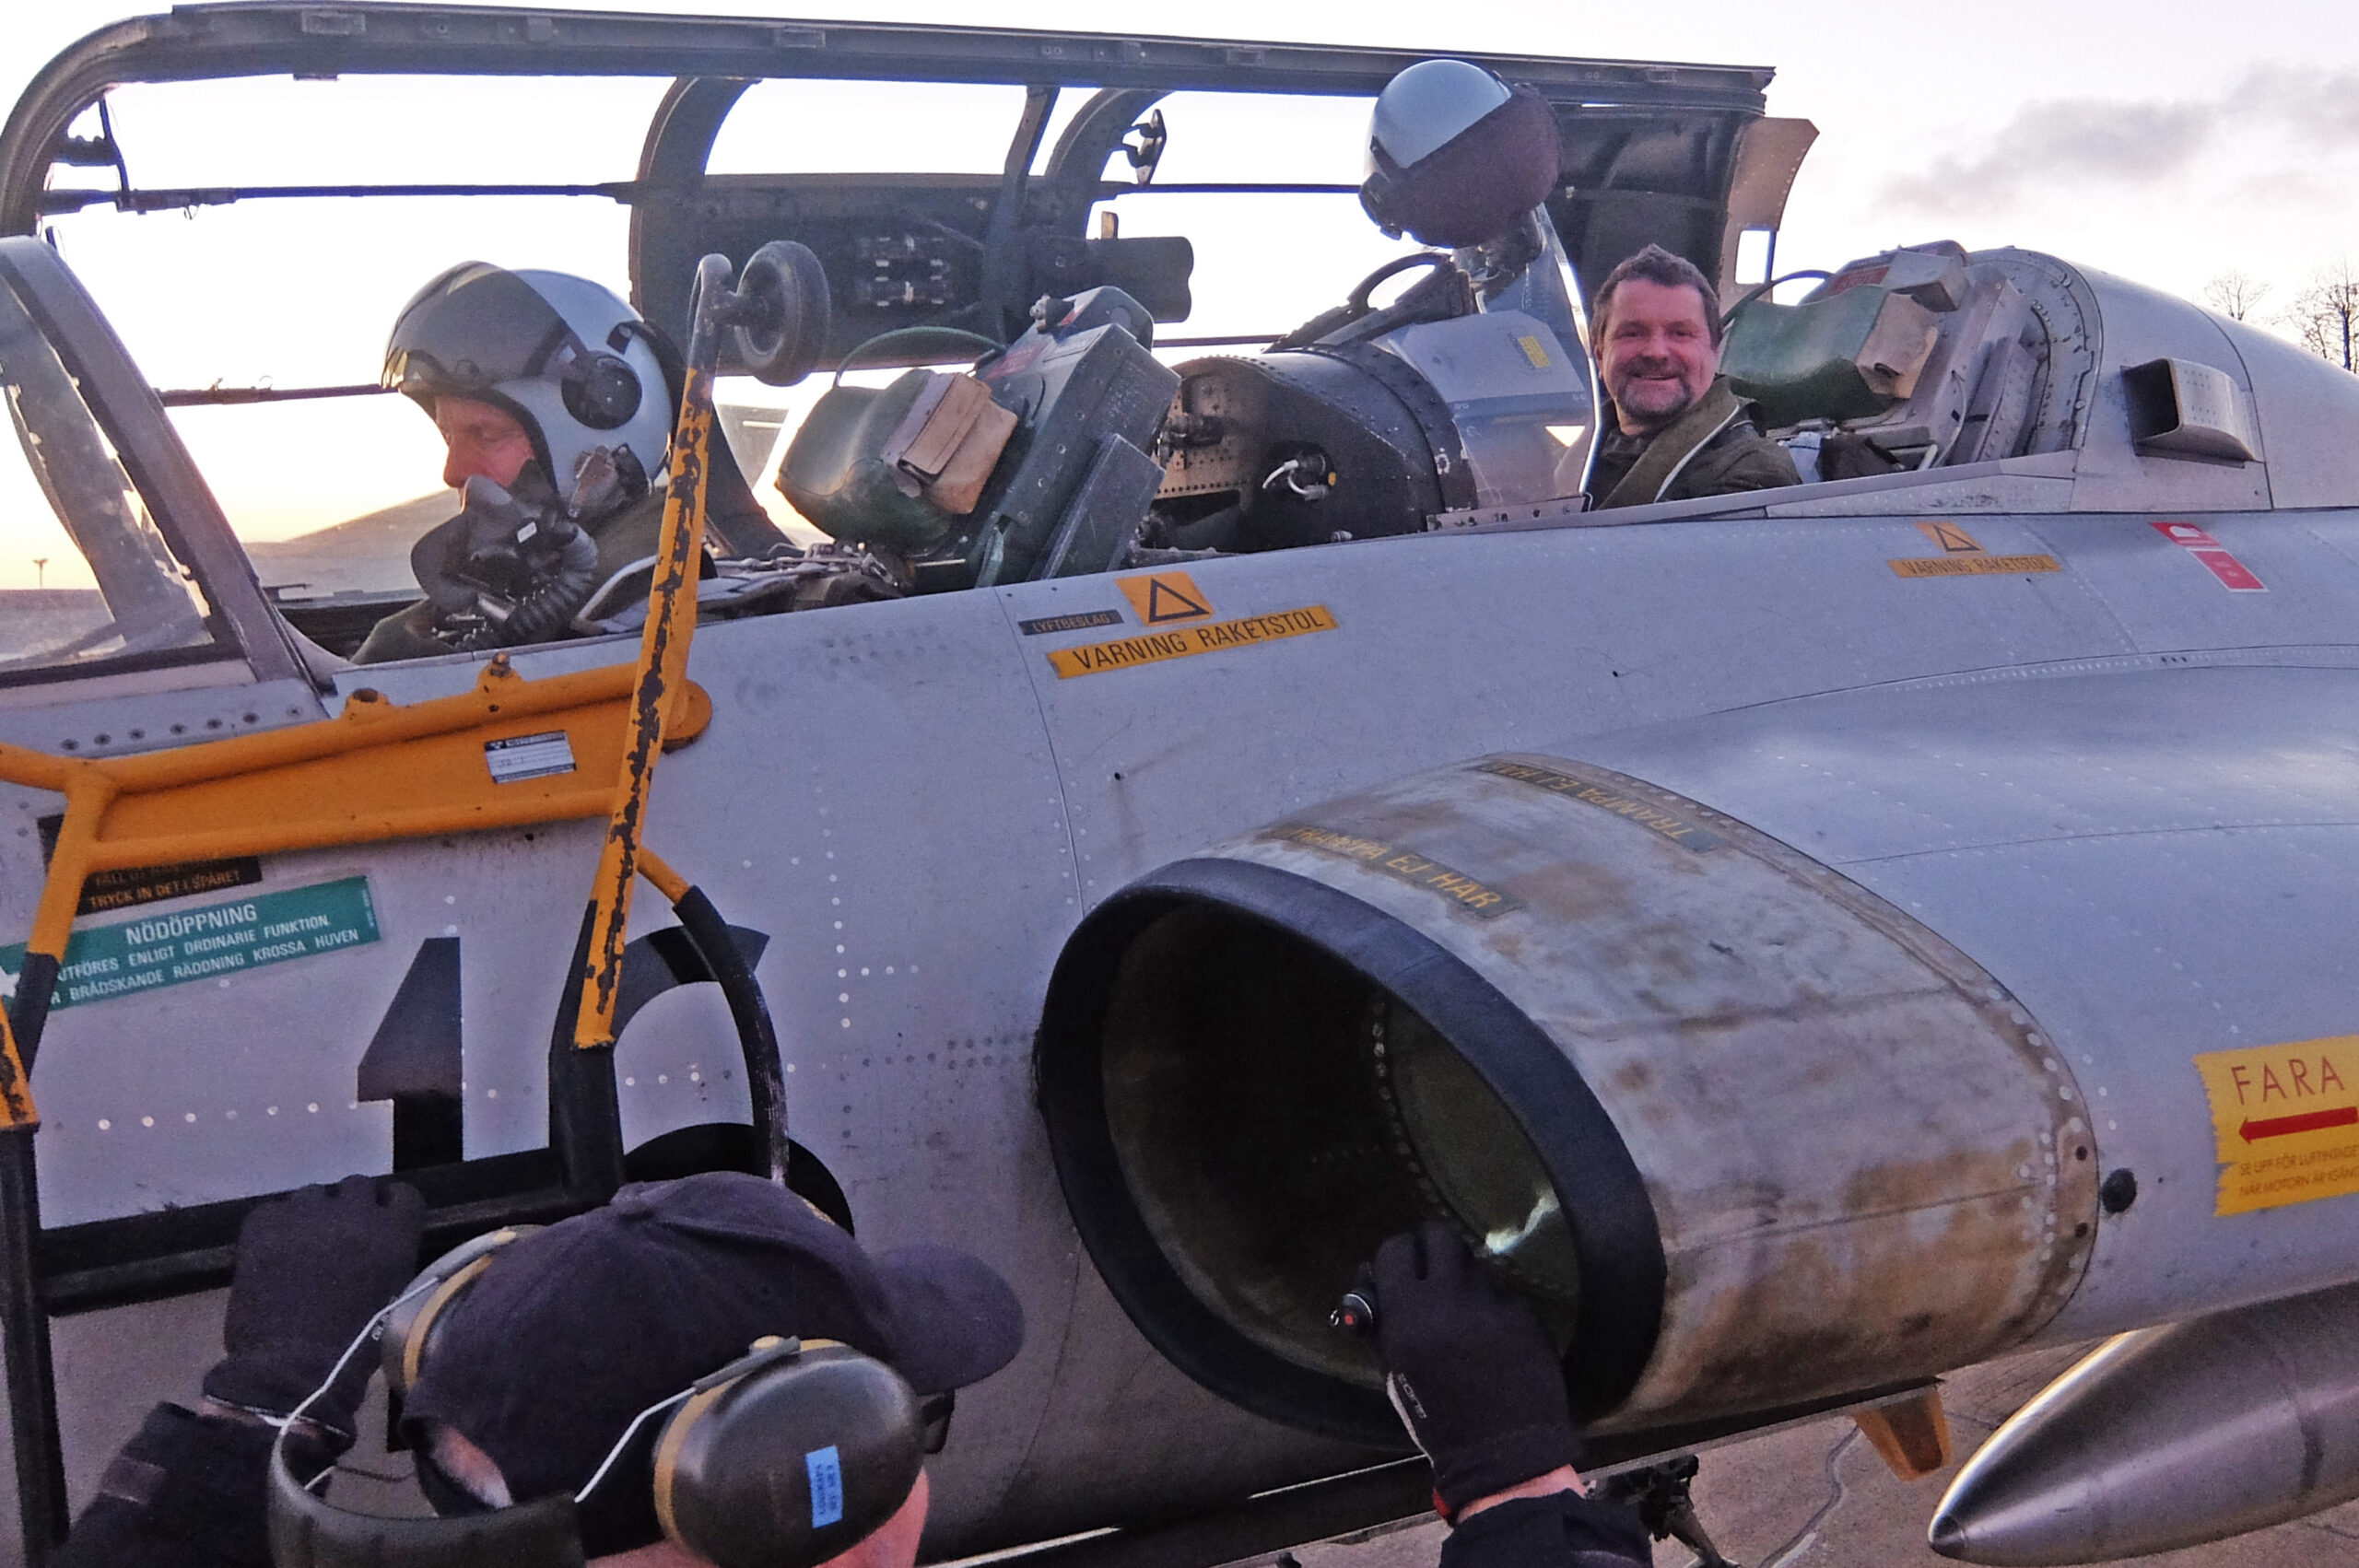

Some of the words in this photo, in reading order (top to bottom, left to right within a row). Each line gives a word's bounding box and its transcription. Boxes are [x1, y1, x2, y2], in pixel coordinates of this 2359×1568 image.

[1902, 559, 1972, 574] VARNING
[1973, 556, 2052, 572] RAKETSTOL
[1032, 614, 1109, 633] LYFTBESLAG
[1073, 633, 1188, 670] VARNING
[1198, 609, 1325, 649] RAKETSTOL
[1578, 788, 1694, 839] TRAMPA
[137, 886, 152, 900] IN
[1386, 854, 1431, 873] EJ
[1426, 872, 1502, 908] HÄR
[126, 903, 258, 946] NÖDÖPPNING
[129, 945, 175, 966] ENLIGT
[185, 929, 256, 954] ORDINARIE
[264, 914, 329, 939] FUNKTION
[70, 968, 164, 1001] BRÅDSKANDE
[252, 940, 307, 962] KROSSA
[315, 928, 359, 949] HUVEN
[2231, 1055, 2344, 1106] FARA
